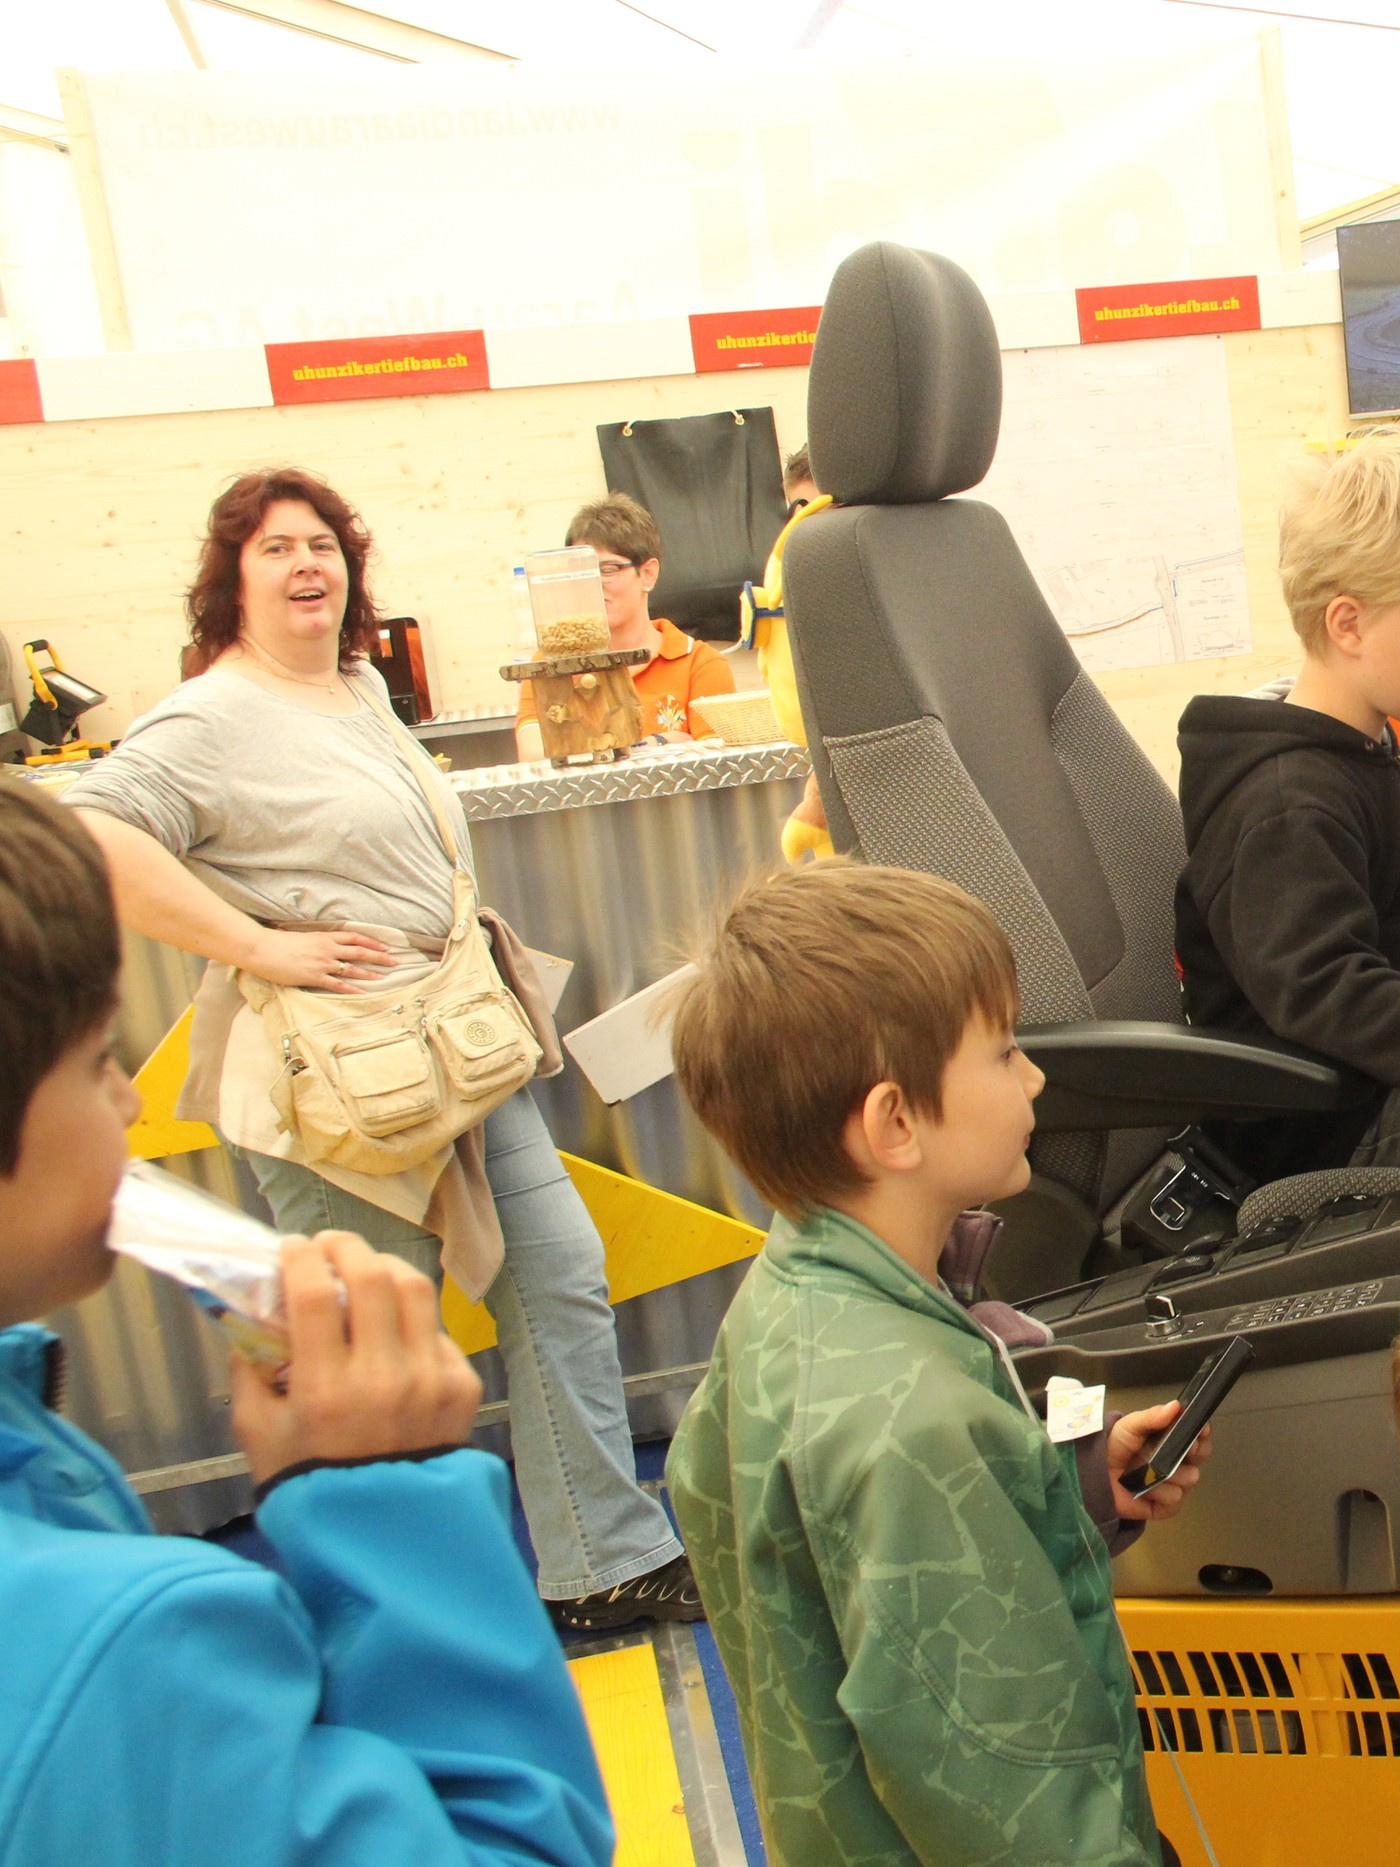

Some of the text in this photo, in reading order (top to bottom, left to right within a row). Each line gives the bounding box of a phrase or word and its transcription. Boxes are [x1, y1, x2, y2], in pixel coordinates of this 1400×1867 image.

[1095, 297, 1241, 321] uhunzikertiefbau.ch
[716, 330, 818, 350] uhunzikertie
[292, 353, 468, 381] uhunzikertiefbau.ch
